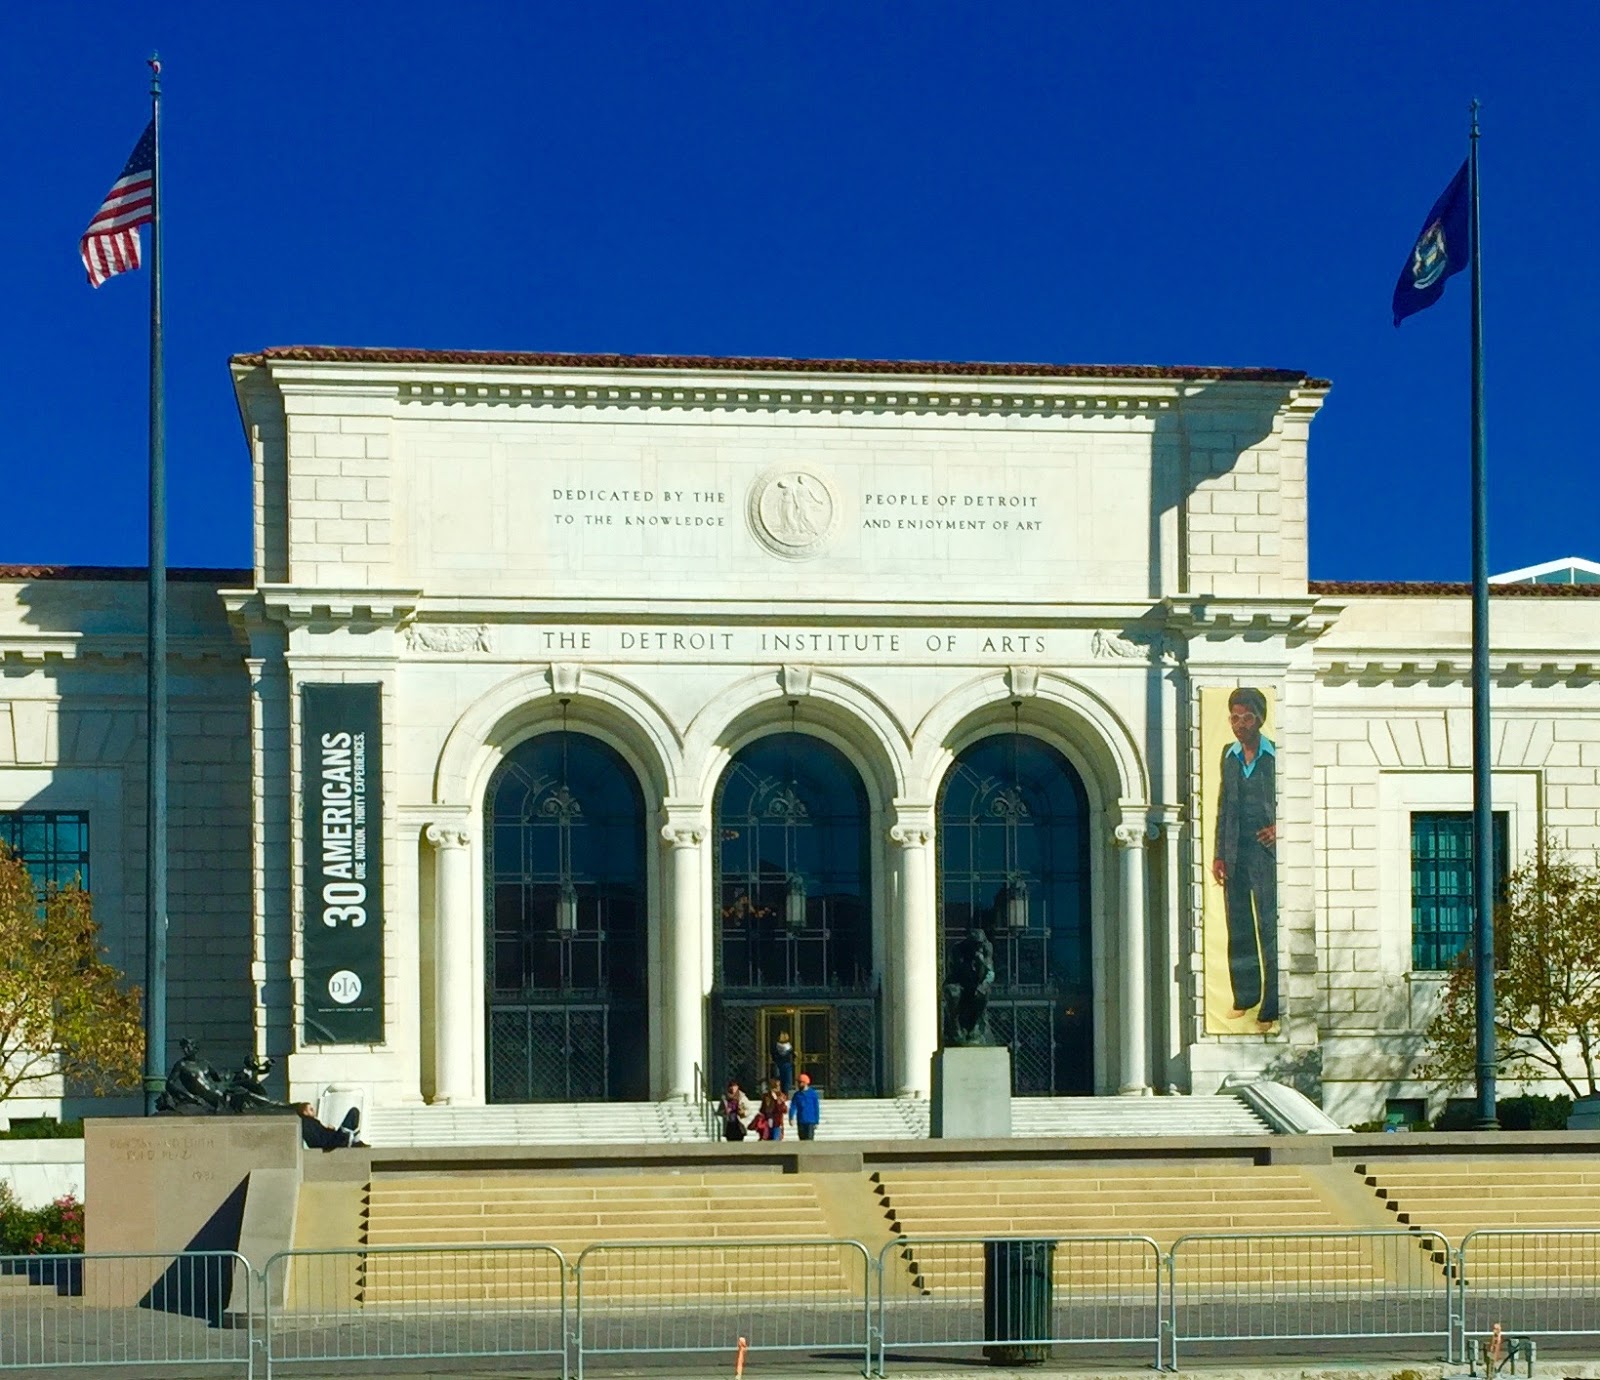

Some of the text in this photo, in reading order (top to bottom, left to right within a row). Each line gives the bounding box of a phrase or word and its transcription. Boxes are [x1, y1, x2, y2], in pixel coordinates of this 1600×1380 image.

[552, 488, 726, 504] DEDICATED BY THE
[865, 493, 1038, 508] PEOPLE OF DETROIT
[553, 513, 725, 527] TO THE KNOWLEDGE
[862, 517, 1043, 532] AND ENJOYMENT OF ART
[542, 631, 1046, 654] THE DETROIT INSTITUTE OF ARTS
[353, 731, 366, 880] ONE NATION. THIRTY EXPERIENCES.
[321, 732, 367, 928] 30 AMERICANS
[331, 977, 359, 997] DIA
